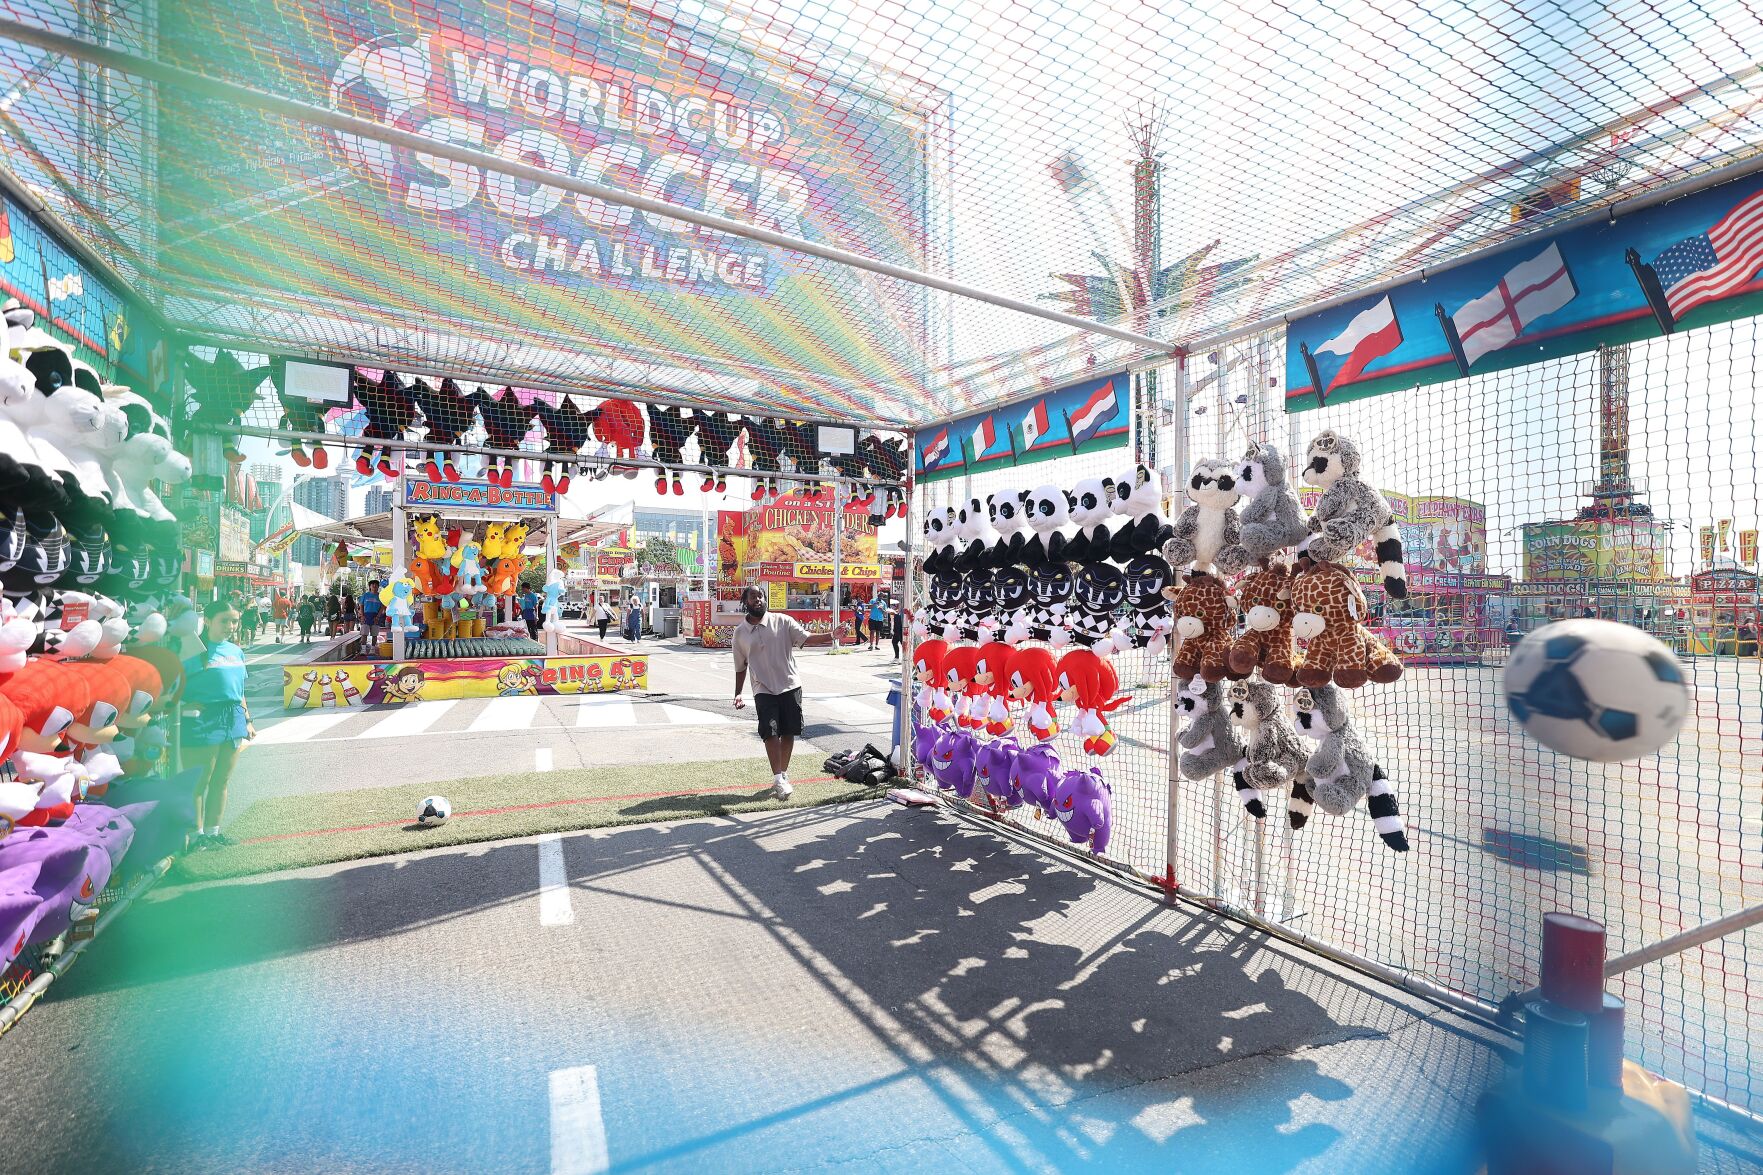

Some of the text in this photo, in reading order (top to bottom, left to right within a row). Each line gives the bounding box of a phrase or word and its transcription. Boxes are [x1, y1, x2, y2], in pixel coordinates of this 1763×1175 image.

[406, 117, 810, 241] SOCCER
[501, 232, 765, 286] CHALLENGE
[765, 507, 819, 530] CHICKEN
[823, 511, 875, 535] TEDERS
[1562, 534, 1597, 549] DOGS
[852, 565, 878, 578] Chips
[1704, 579, 1748, 589] PIZZA
[542, 663, 602, 685] RING
[610, 661, 624, 678] A
